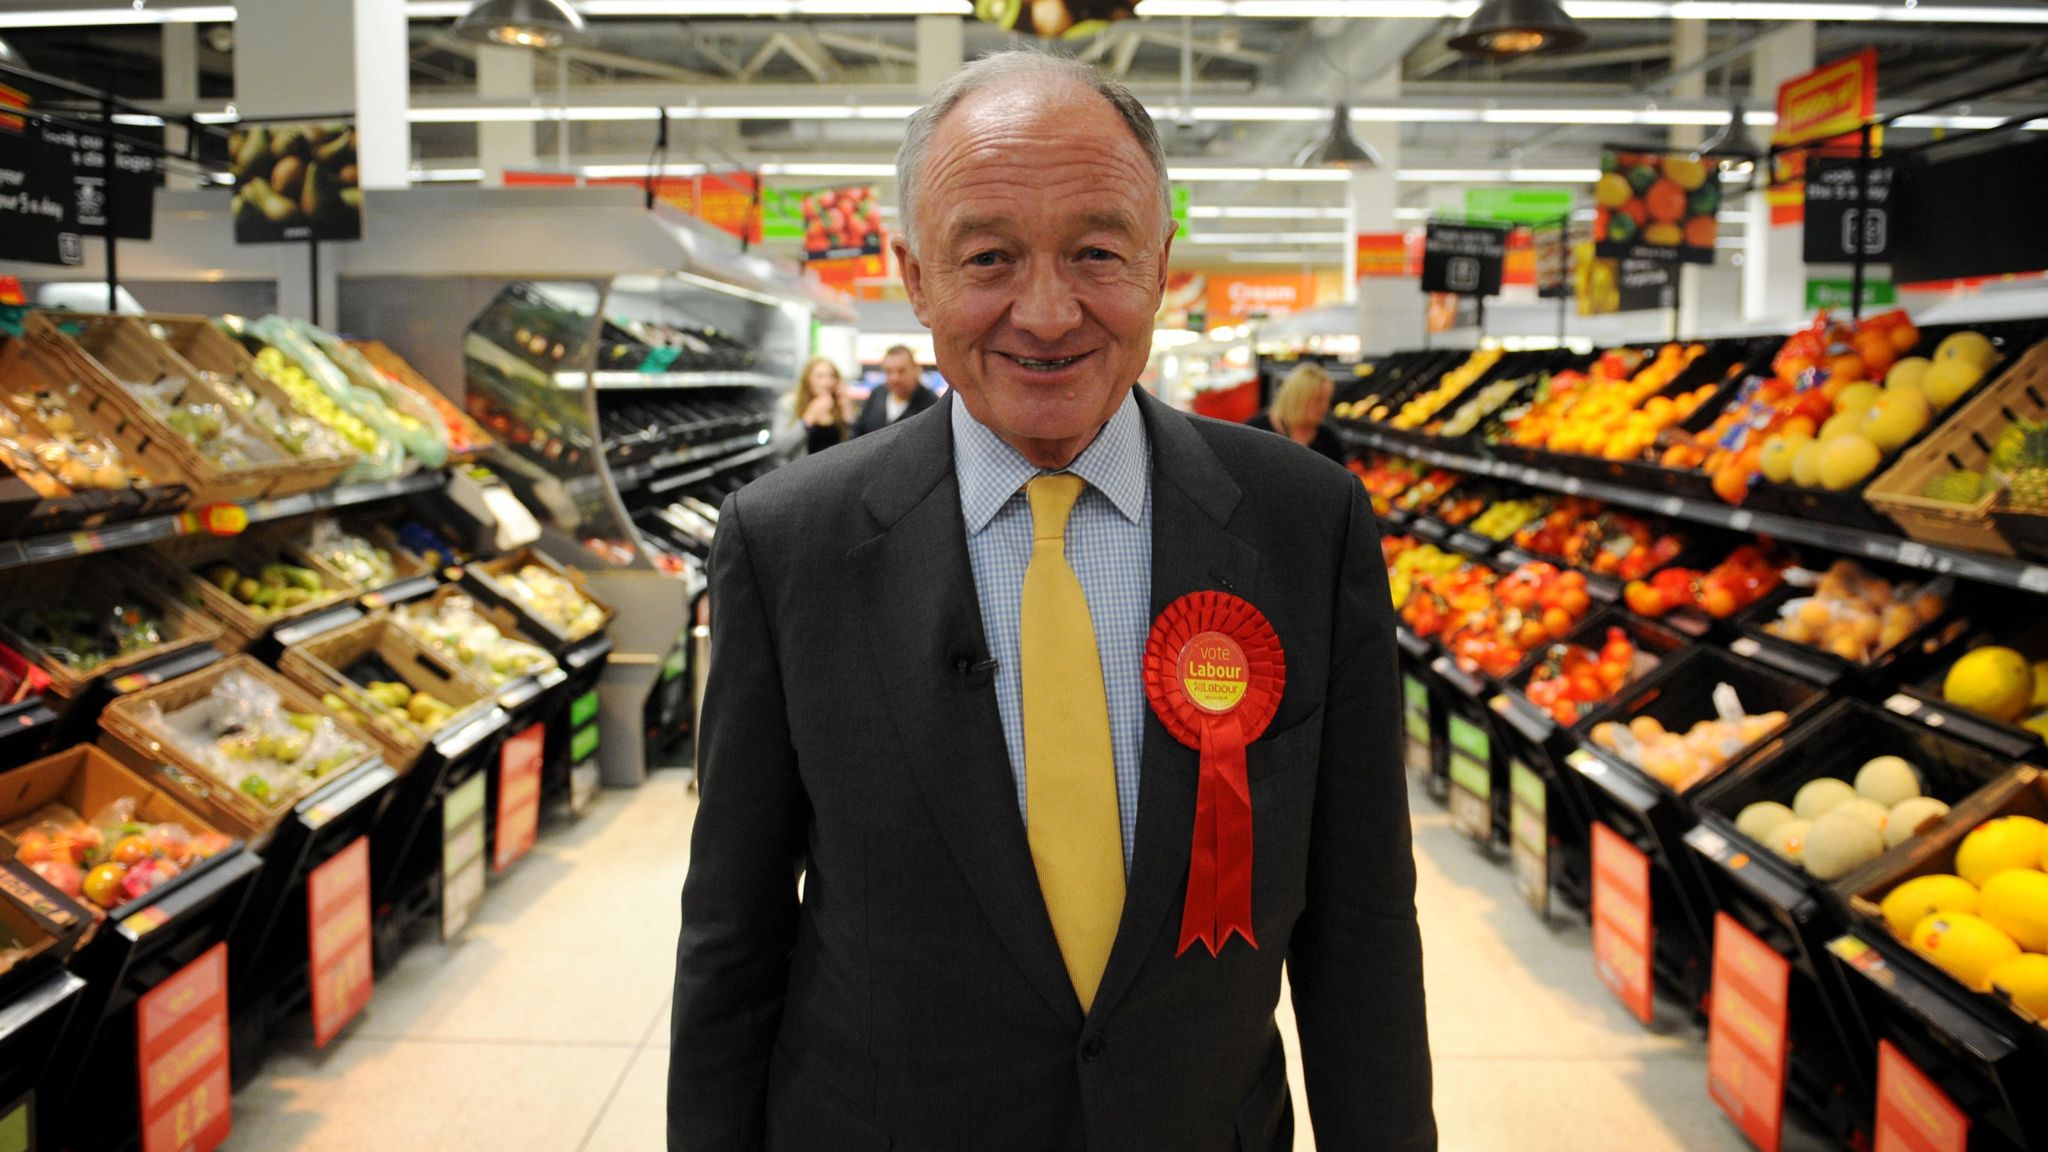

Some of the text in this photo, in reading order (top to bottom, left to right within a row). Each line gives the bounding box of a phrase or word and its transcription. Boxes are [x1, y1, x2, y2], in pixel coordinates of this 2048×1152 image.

[1228, 282, 1297, 302] Cream
[1200, 646, 1231, 661] vote
[1189, 660, 1242, 679] Labour
[1202, 681, 1238, 694] Labour
